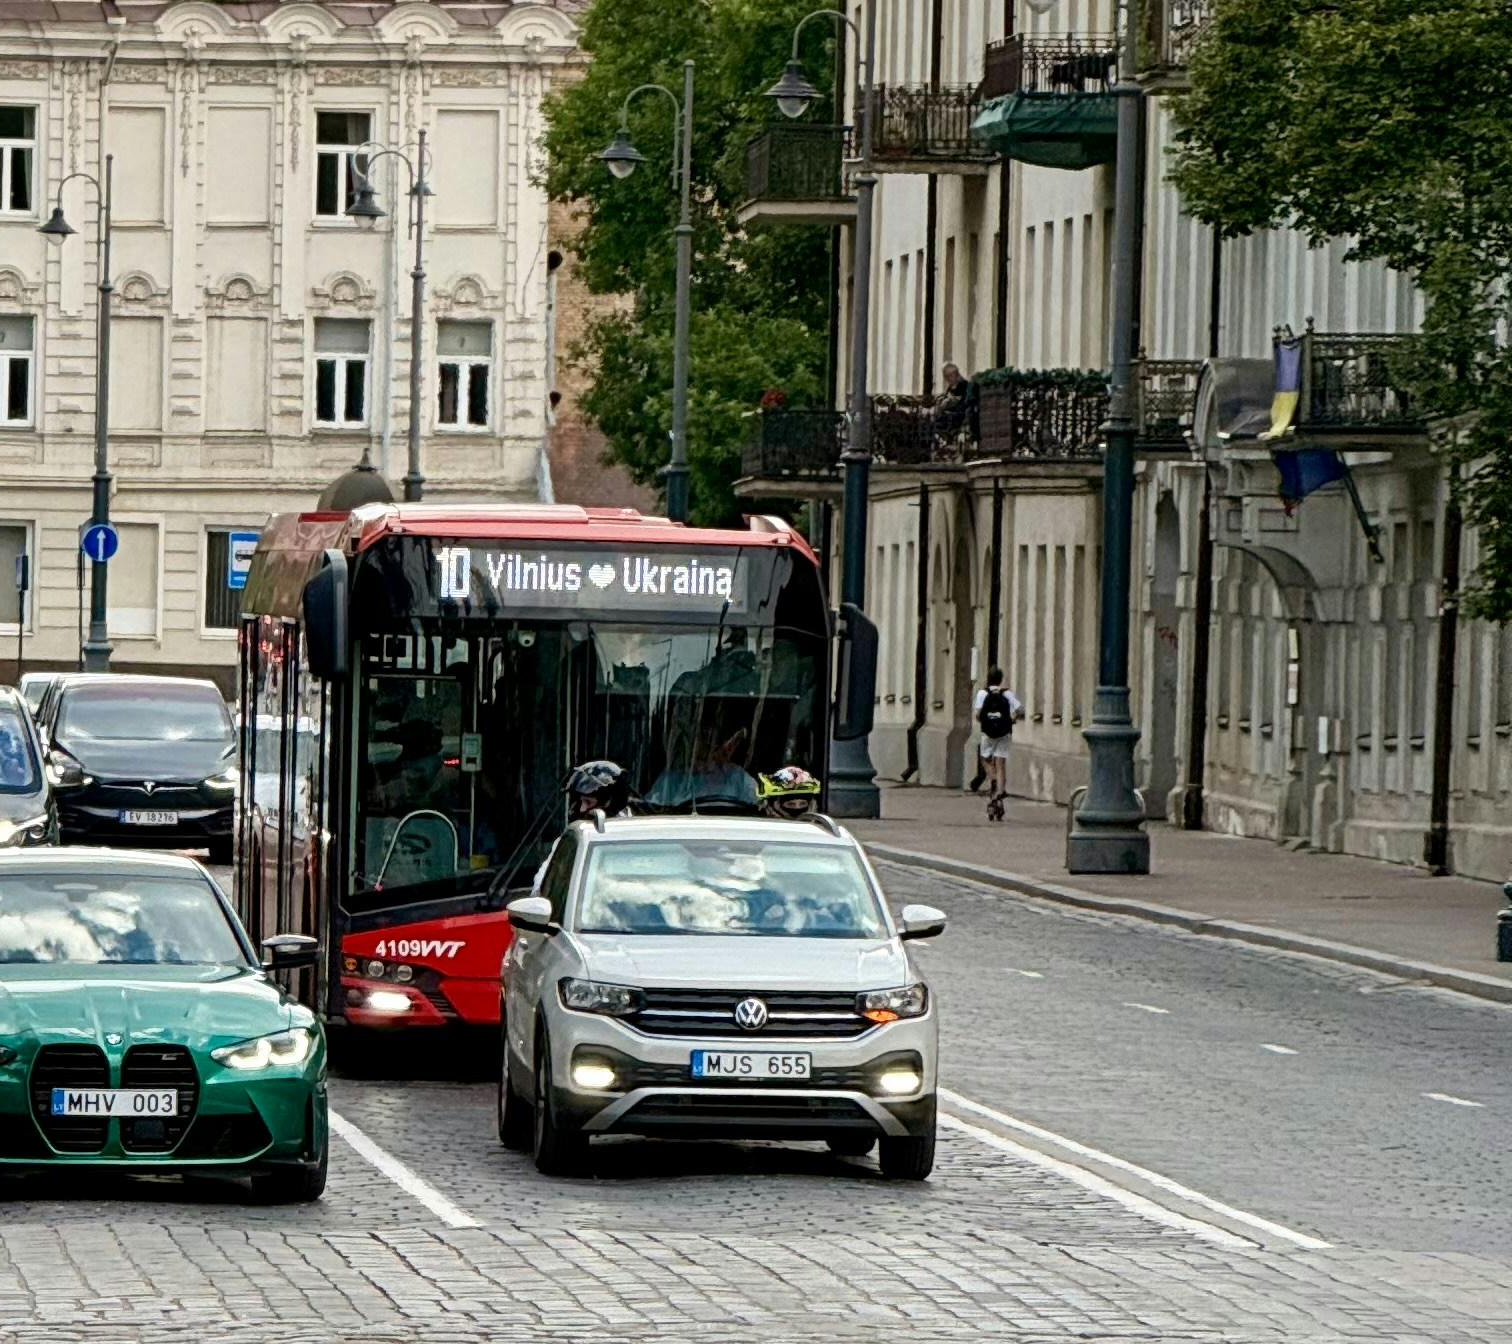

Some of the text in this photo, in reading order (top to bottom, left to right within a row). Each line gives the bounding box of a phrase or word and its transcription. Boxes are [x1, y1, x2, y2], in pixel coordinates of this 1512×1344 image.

[436, 548, 471, 599] 10
[486, 554, 582, 591] Vilnius
[707, 1054, 807, 1075] MJS 655
[68, 1093, 173, 1113] MHV 003
